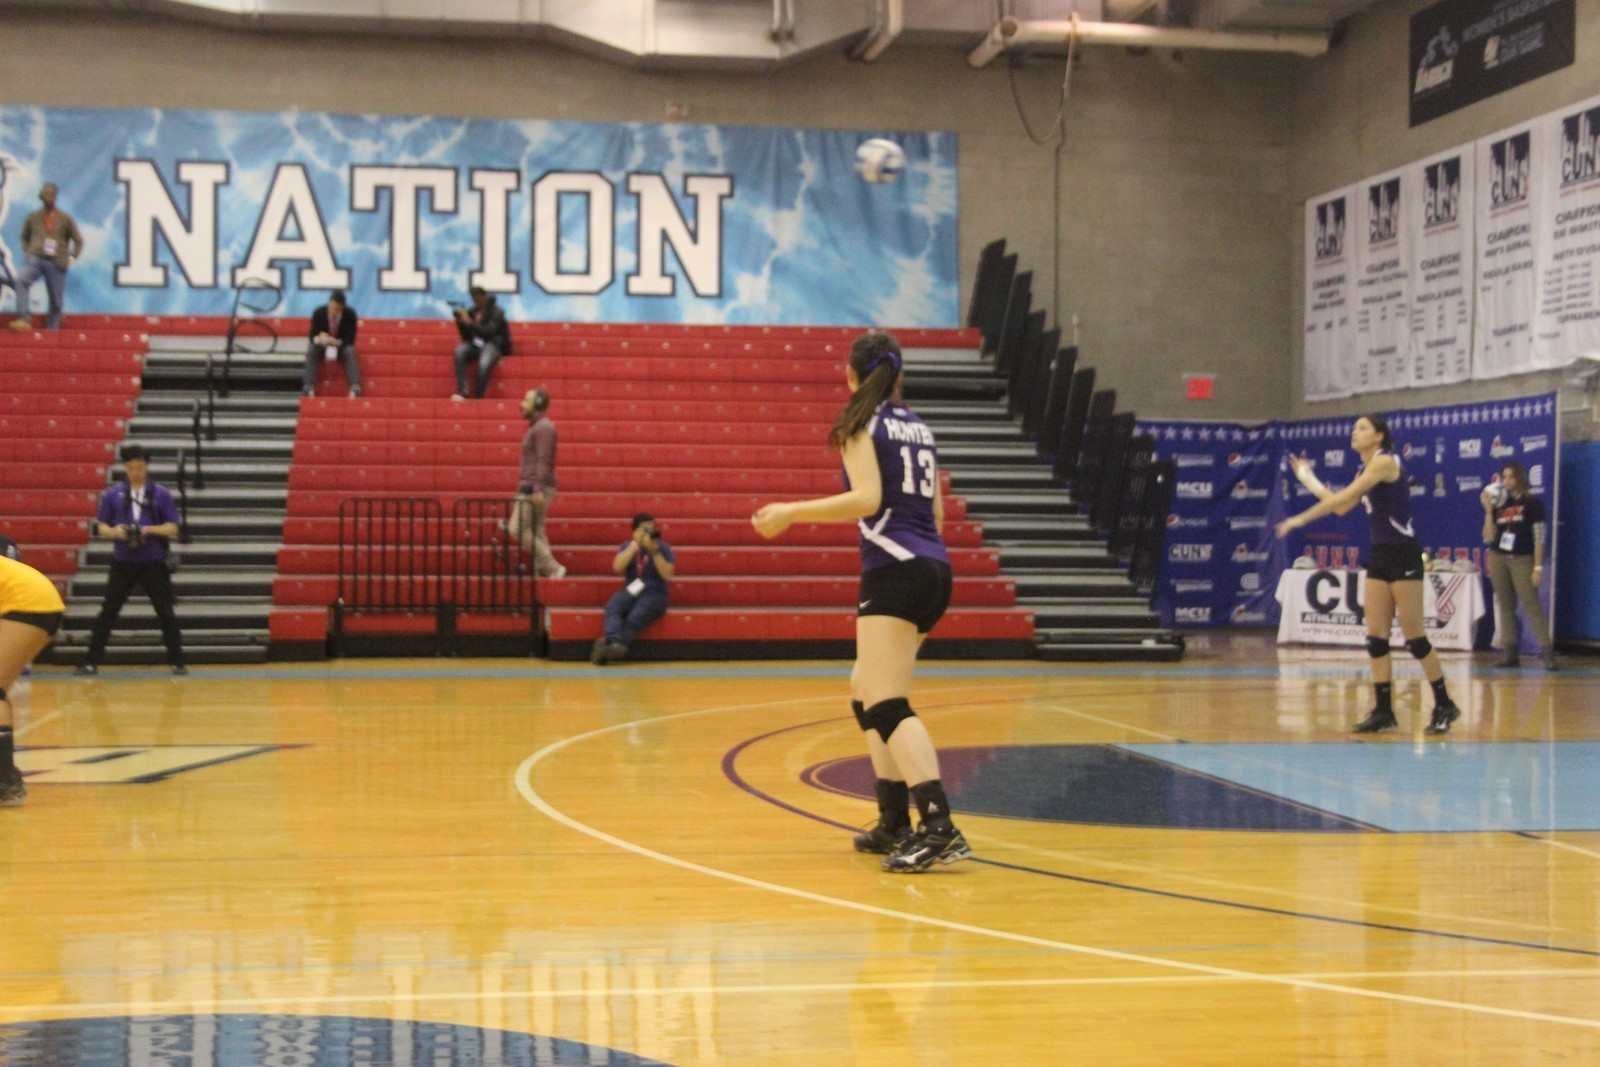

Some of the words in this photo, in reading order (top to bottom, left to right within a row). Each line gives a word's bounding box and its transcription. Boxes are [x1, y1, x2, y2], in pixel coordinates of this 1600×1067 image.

[114, 158, 733, 298] NATION
[883, 418, 935, 446] HUNTE
[900, 446, 935, 498] 13
[1176, 482, 1213, 493] MCU
[1302, 613, 1358, 625] ATHLETIC
